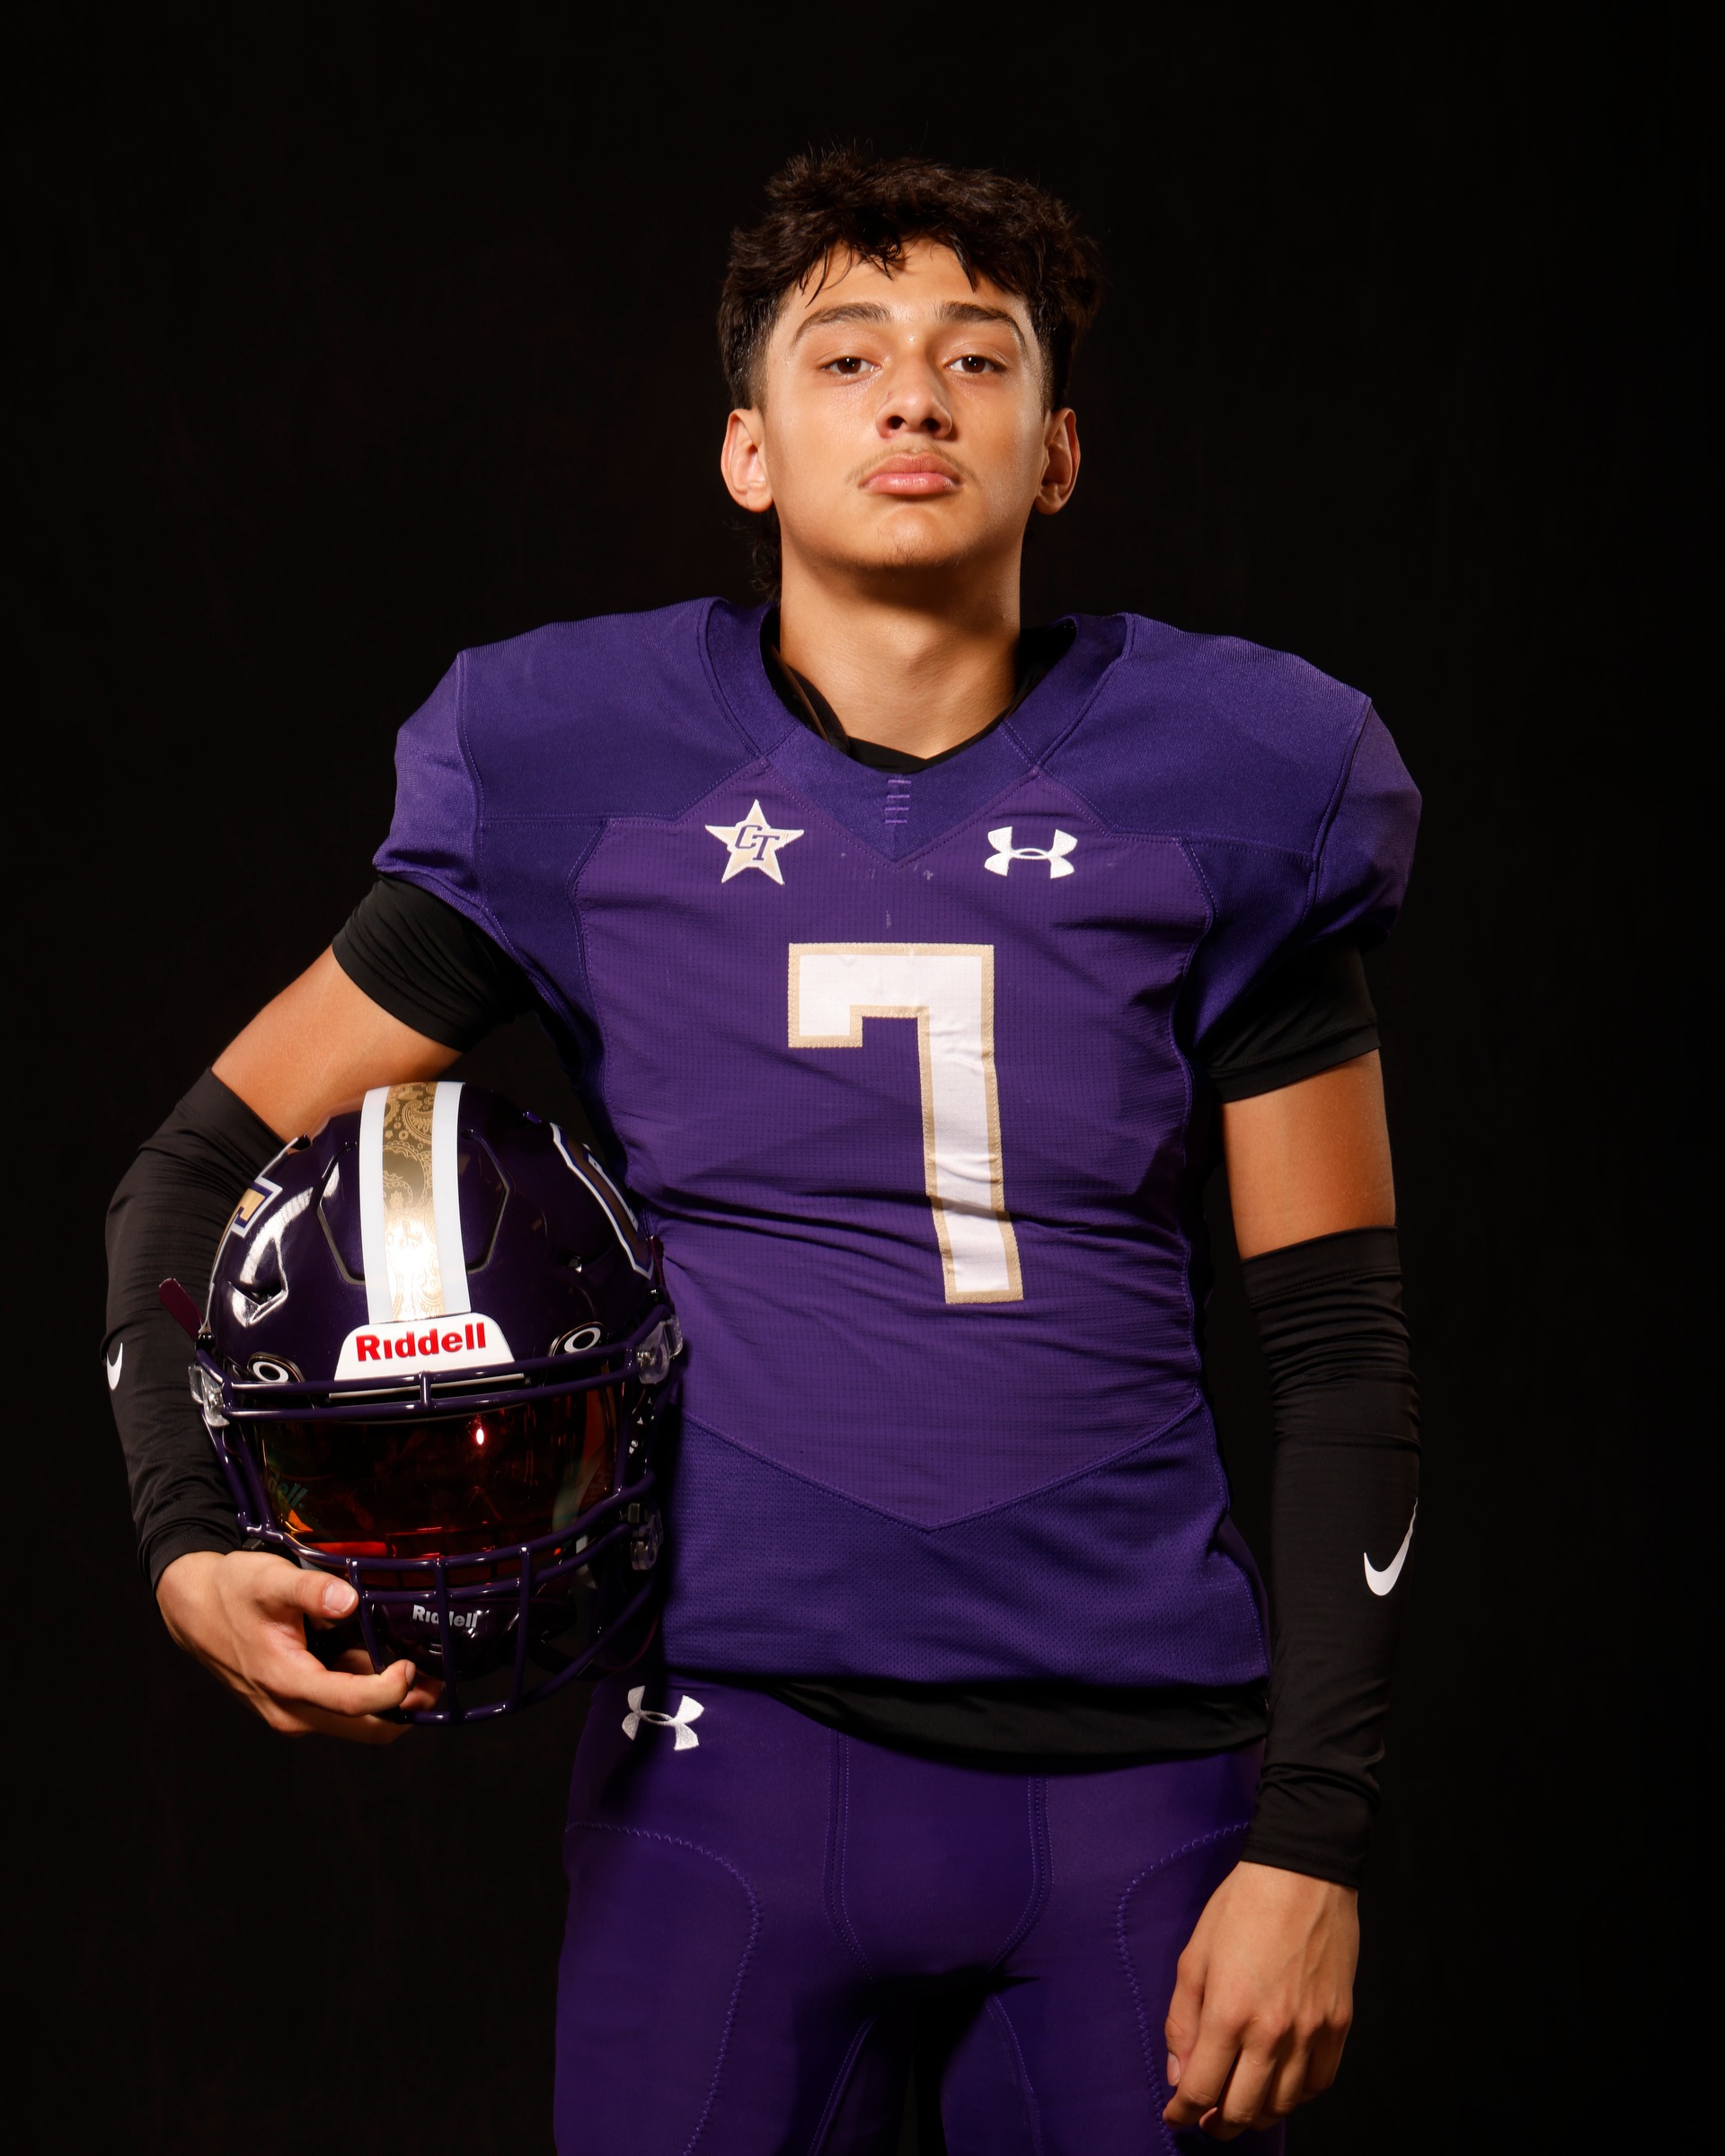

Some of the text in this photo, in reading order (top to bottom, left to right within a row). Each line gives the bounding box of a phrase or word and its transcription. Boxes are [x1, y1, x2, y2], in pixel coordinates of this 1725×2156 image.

[734, 824, 781, 862] CT
[788, 942, 1024, 1304] 7
[356, 1321, 487, 1362] Riddell
